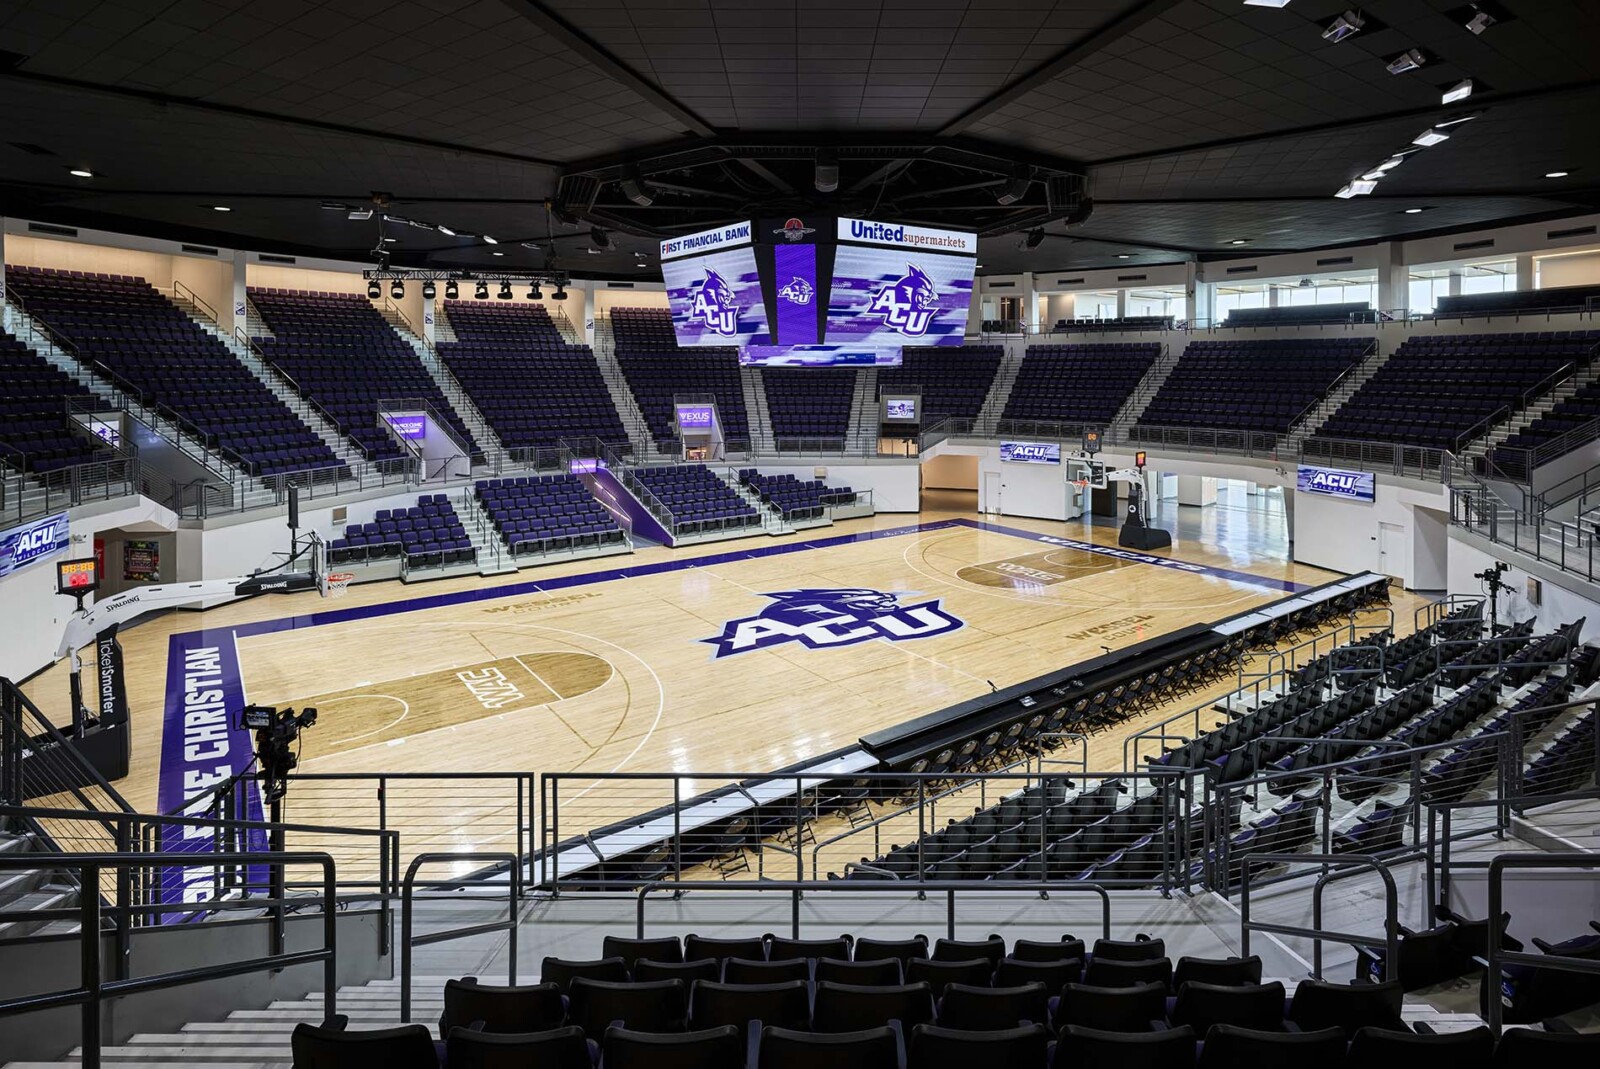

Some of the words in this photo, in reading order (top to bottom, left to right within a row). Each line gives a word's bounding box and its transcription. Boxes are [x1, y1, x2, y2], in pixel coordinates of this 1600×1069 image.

[662, 241, 681, 254] FIRST
[684, 232, 723, 250] FINANCIAL
[726, 226, 749, 241] BANK
[851, 220, 904, 242] United
[904, 233, 966, 249] supermarkets
[782, 289, 810, 303] ACU
[694, 294, 734, 332] ACU
[873, 290, 930, 332] ACU
[1013, 446, 1045, 456] ACU
[1313, 473, 1354, 489] ACU
[17, 525, 55, 555] ACU
[1039, 536, 1206, 571] WILDCATS
[260, 581, 287, 590] SPALDING
[106, 595, 140, 612] SPALDING
[725, 606, 951, 650] ACU
[1065, 615, 1155, 640] WESSEL
[100, 637, 116, 714] TicketSmarter
[184, 646, 230, 762] CHRISTIAN
